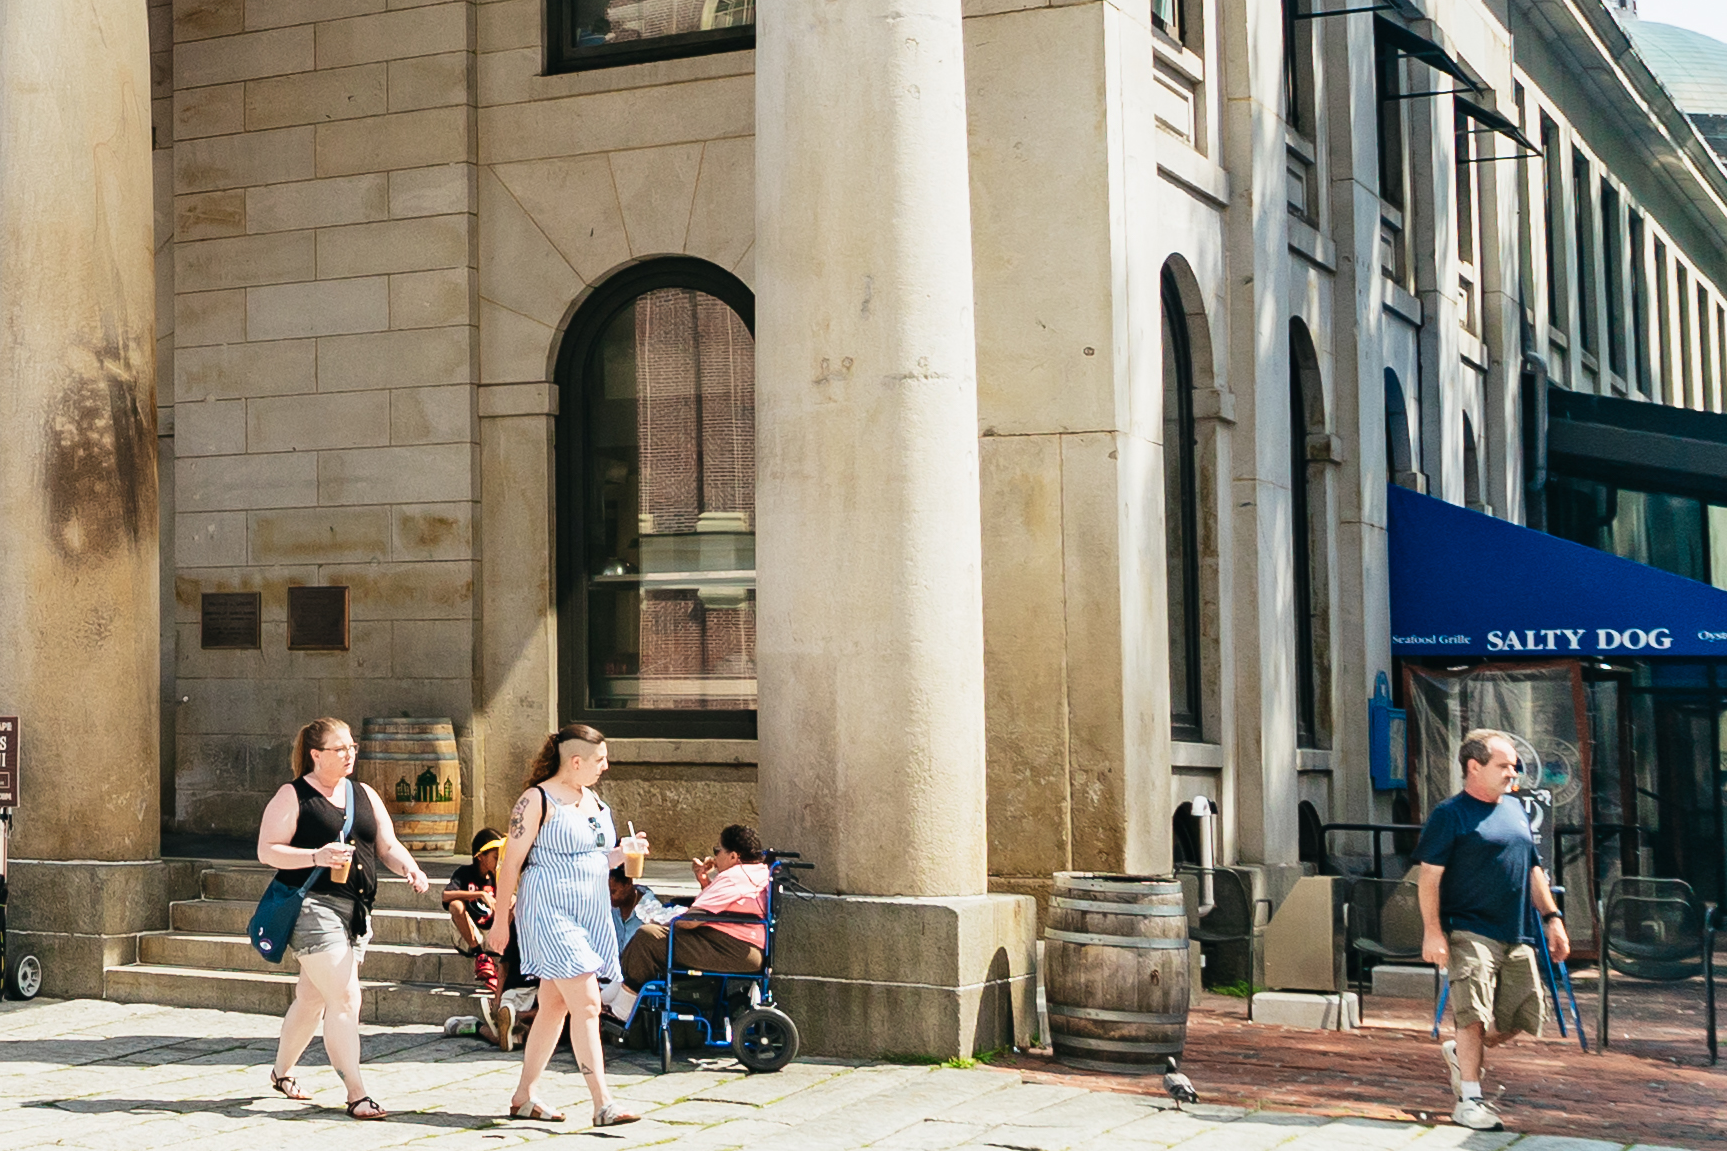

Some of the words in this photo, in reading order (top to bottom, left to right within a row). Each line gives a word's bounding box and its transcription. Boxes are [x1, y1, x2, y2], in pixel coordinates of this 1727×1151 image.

[1392, 635, 1436, 644] Seafood
[1487, 629, 1586, 651] SALTY
[1596, 628, 1673, 650] DOG
